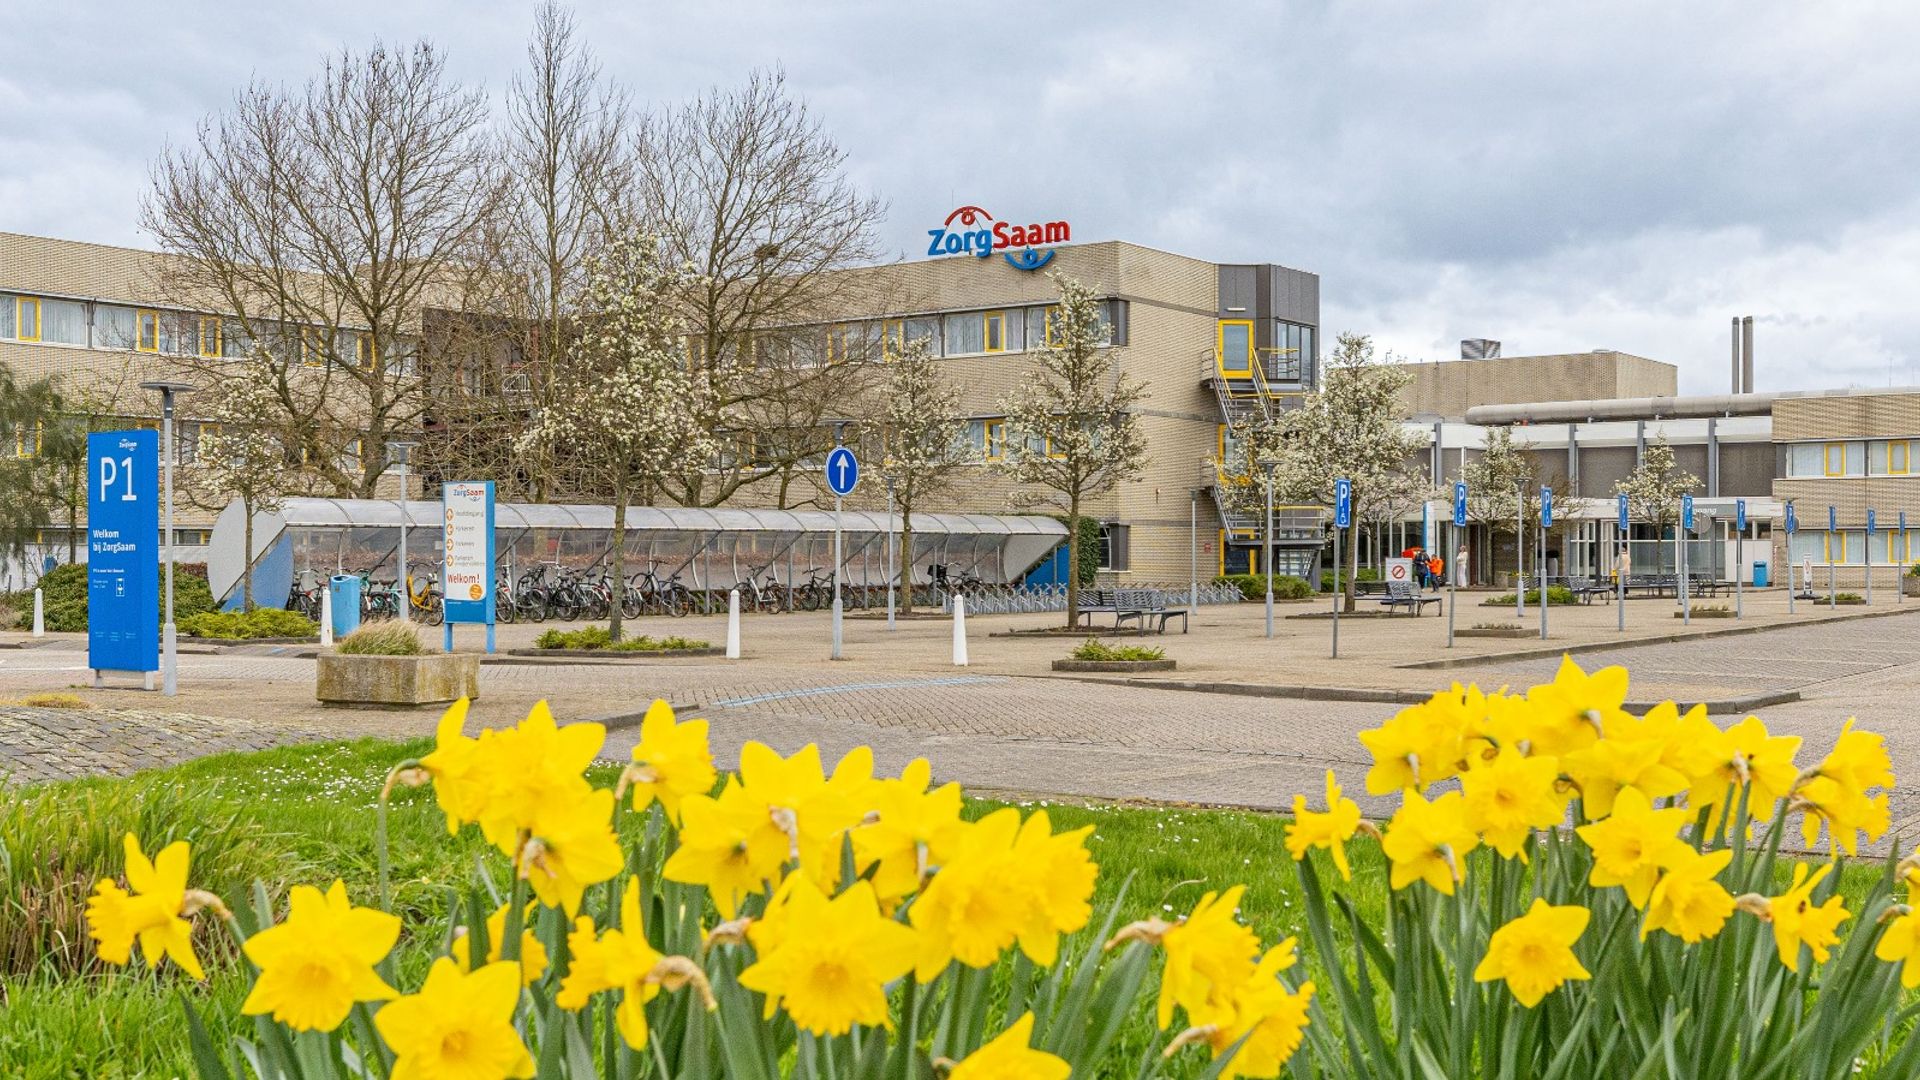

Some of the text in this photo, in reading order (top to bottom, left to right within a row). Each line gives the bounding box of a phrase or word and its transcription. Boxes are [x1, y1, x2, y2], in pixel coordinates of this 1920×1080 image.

[928, 221, 1071, 258] ZorgSaam
[100, 456, 137, 502] P1
[453, 489, 484, 497] ZorgSaam
[1340, 484, 1347, 507] P
[1458, 486, 1464, 507] P
[92, 529, 120, 539] Welkom
[92, 542, 136, 554] bij ZorgSaam
[447, 573, 480, 584] Welkom!
